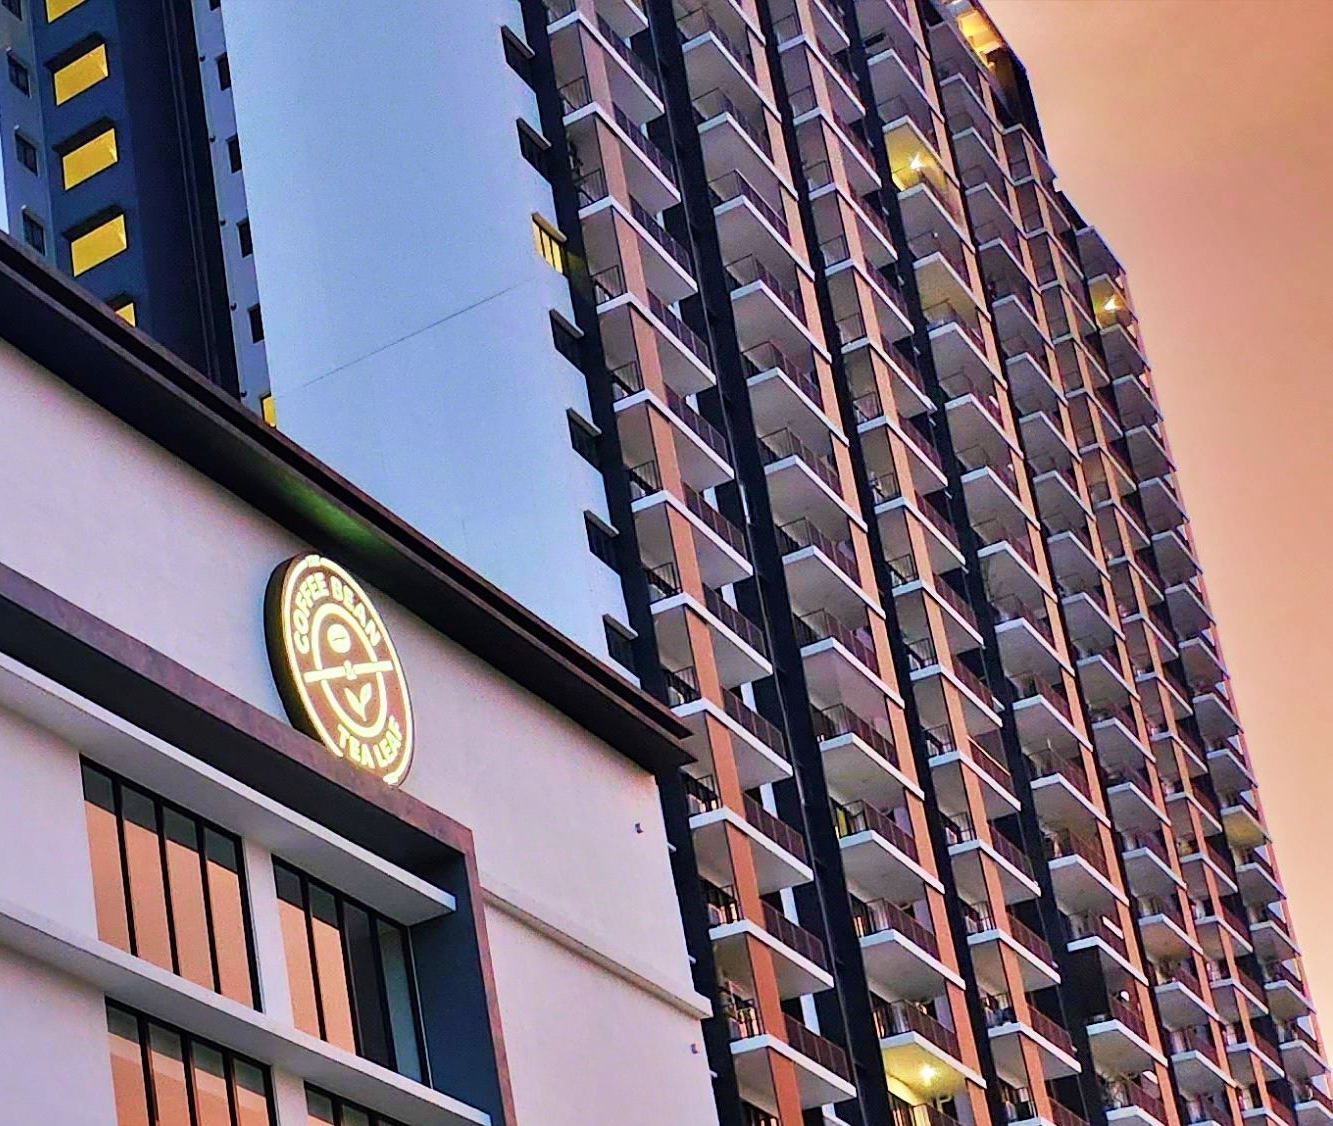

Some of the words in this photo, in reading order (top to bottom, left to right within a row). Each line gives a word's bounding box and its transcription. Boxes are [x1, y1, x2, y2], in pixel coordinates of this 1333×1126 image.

[293, 571, 329, 655] COFFEE
[330, 575, 382, 647] BEAN
[337, 723, 376, 770] TEA
[373, 714, 403, 769] LEAF
